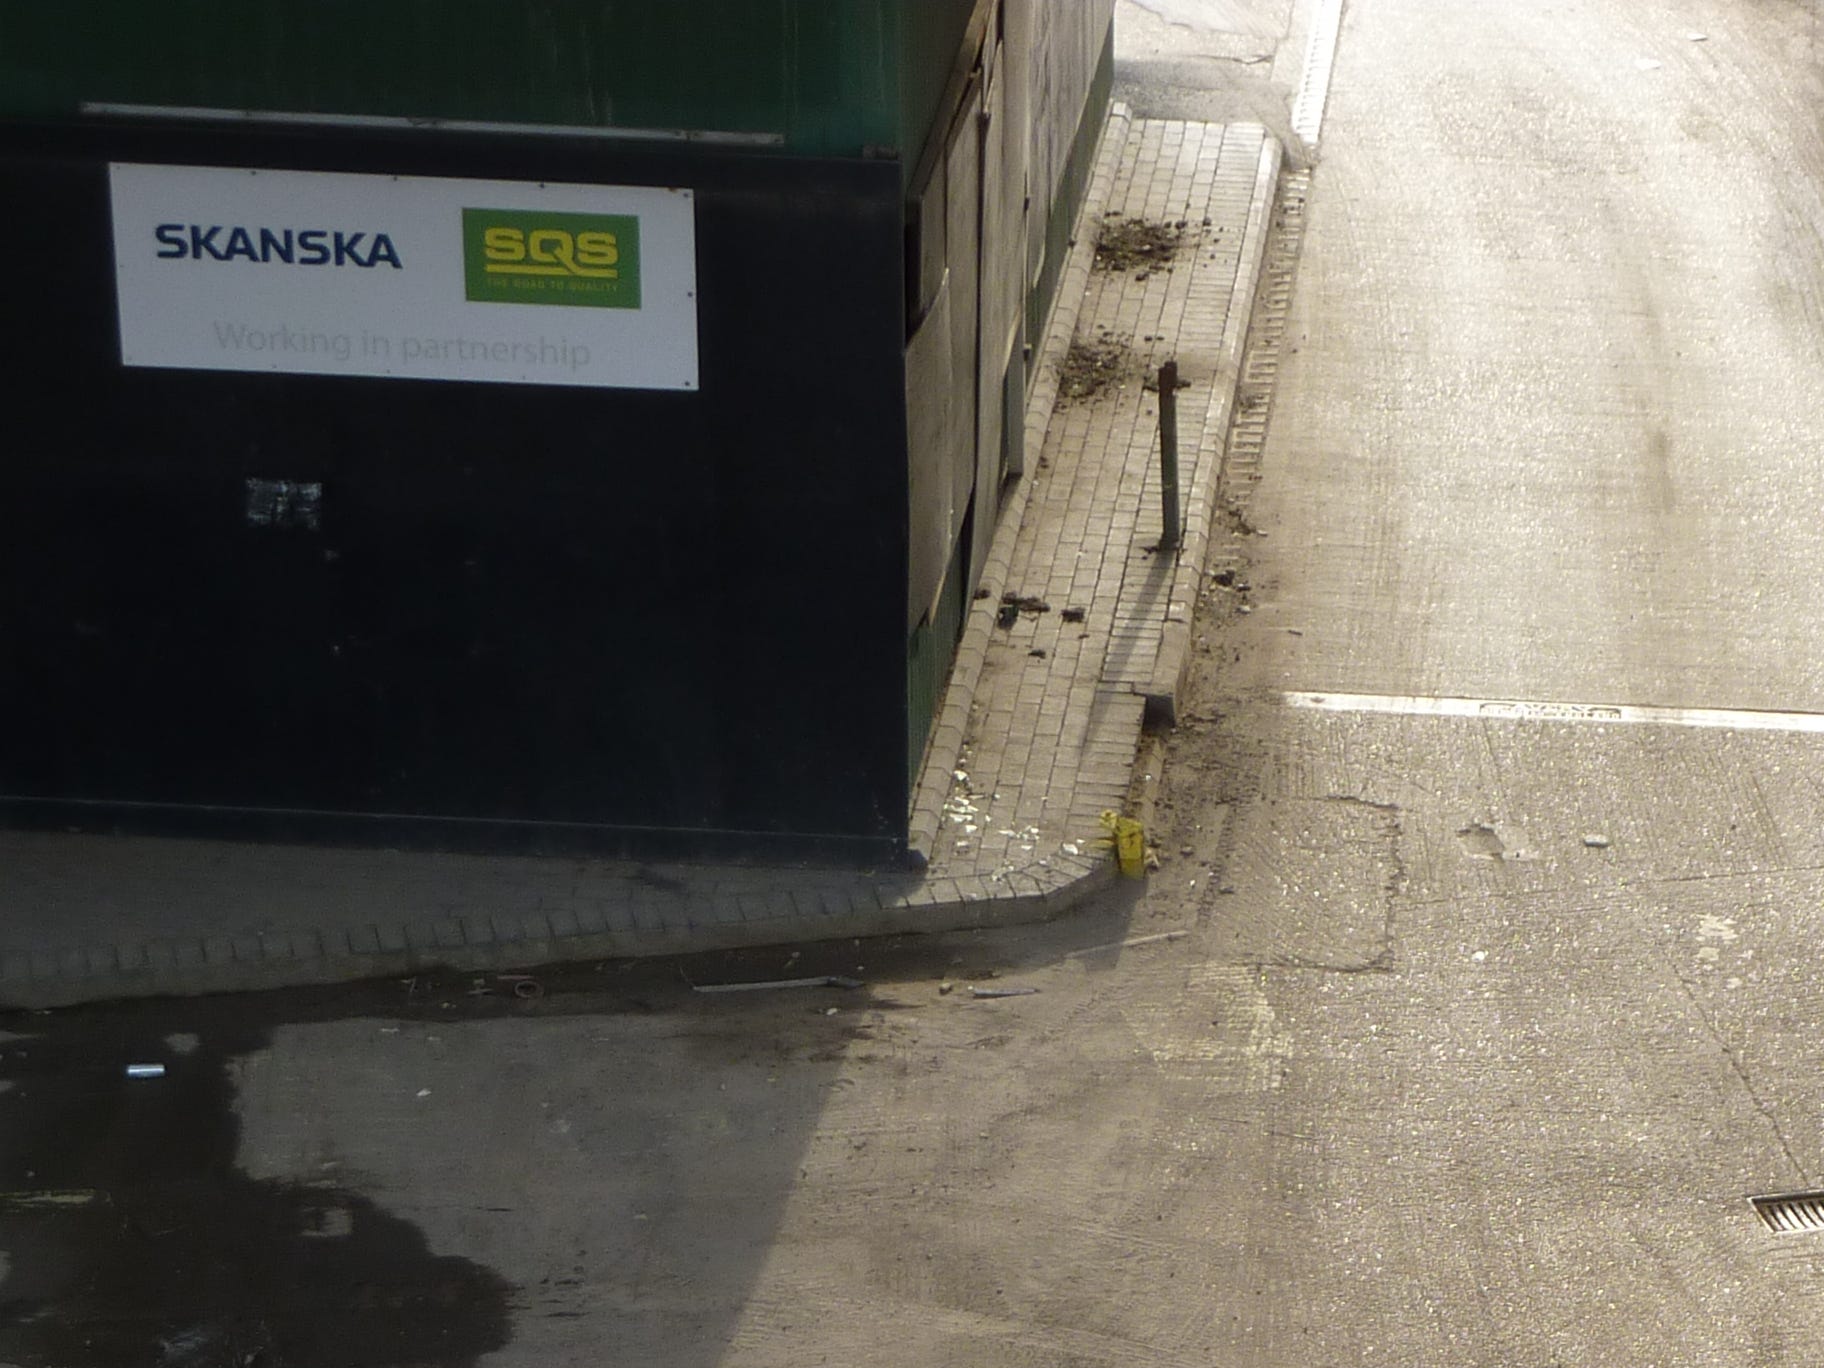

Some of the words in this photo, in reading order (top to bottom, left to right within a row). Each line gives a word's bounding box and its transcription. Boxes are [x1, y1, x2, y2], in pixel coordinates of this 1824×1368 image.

[155, 223, 403, 269] SKANSKA
[485, 227, 618, 272] SQS
[213, 321, 351, 361] Working
[361, 329, 391, 356] in
[402, 333, 591, 372] partnership
